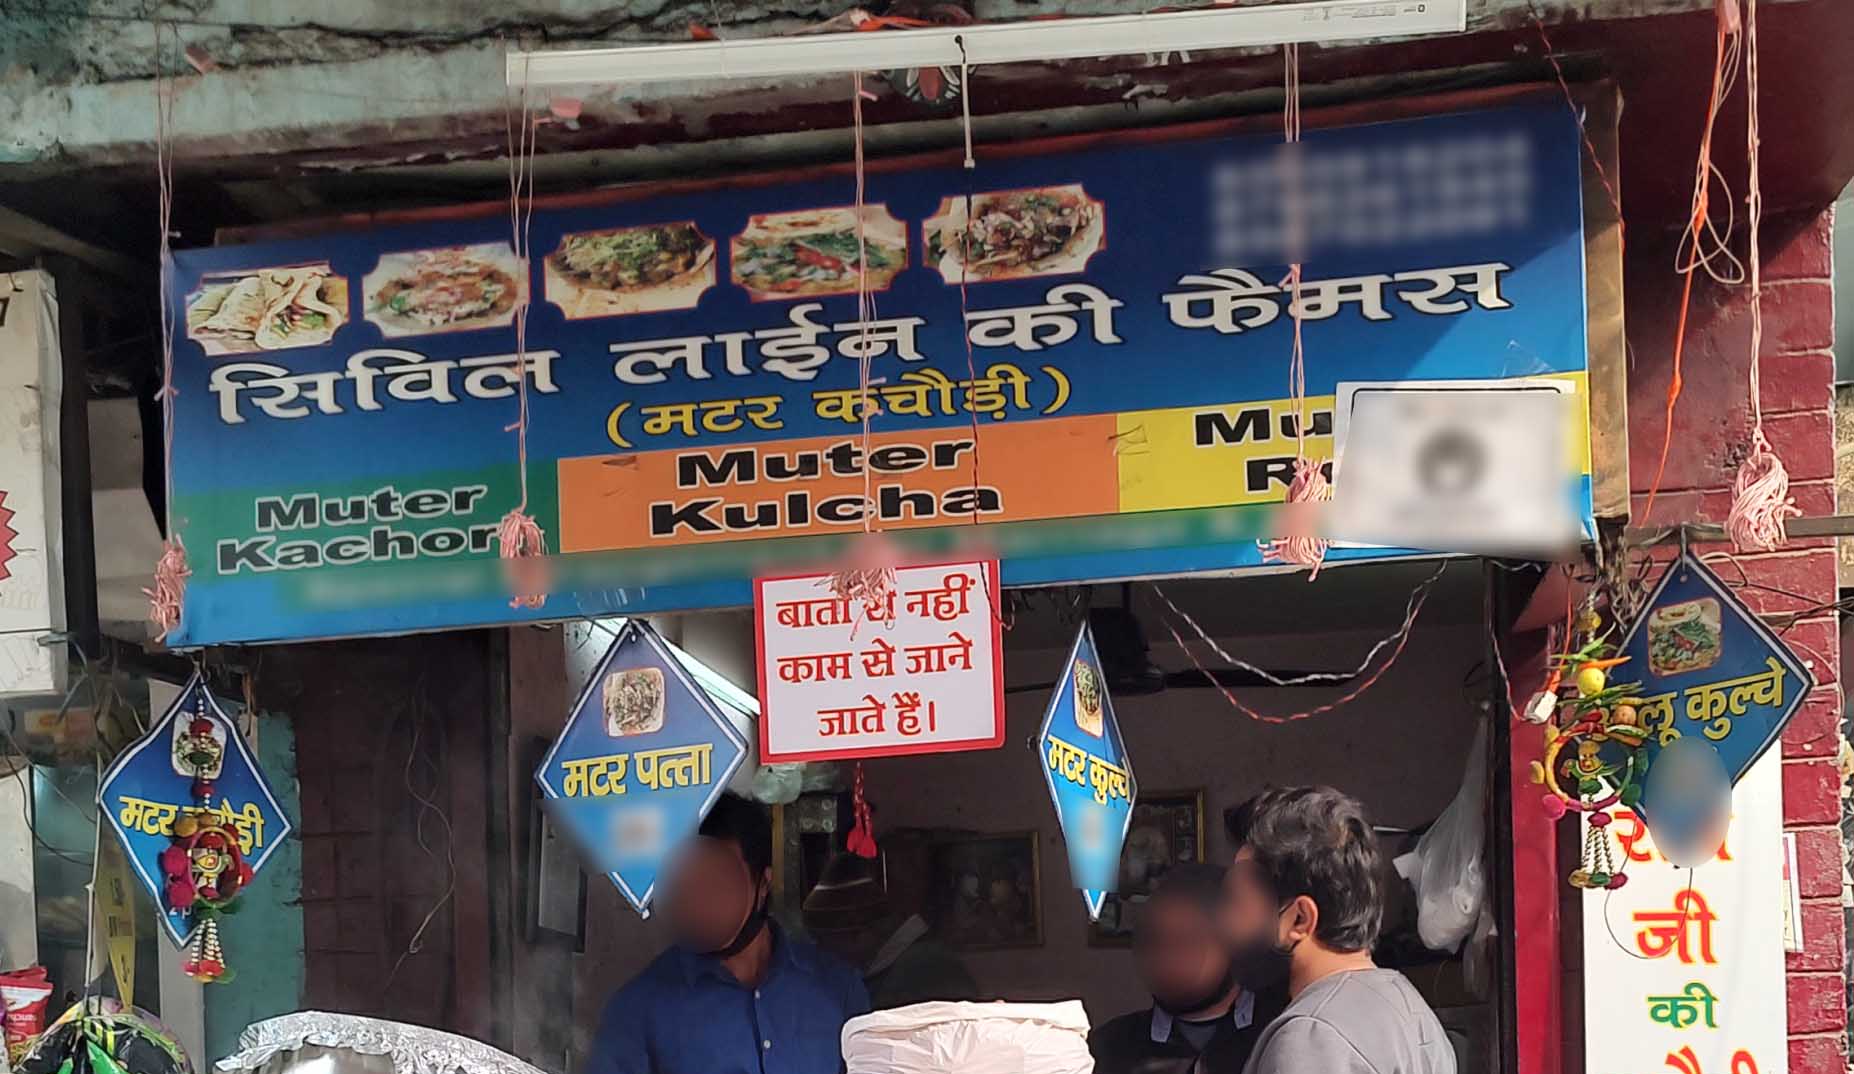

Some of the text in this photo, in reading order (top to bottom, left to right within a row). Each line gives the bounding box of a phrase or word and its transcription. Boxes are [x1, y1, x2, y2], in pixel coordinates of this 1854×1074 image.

[209, 261, 1512, 424] सिविल लाईन की फैमस
[676, 437, 975, 489] Muter
[255, 484, 489, 531] Muter
[650, 483, 1003, 537] Kulcha
[217, 528, 503, 576] Kachor
[904, 573, 976, 621] नहीं
[776, 632, 973, 683] काम से जाने
[817, 694, 886, 737] जाते
[1684, 656, 1786, 740] कुल्चे
[561, 743, 713, 798] मटर पत्ता
[1048, 735, 1087, 787] मटर
[119, 795, 179, 836] मटर
[1632, 888, 1718, 964] जी
[1648, 982, 1719, 1029] की
